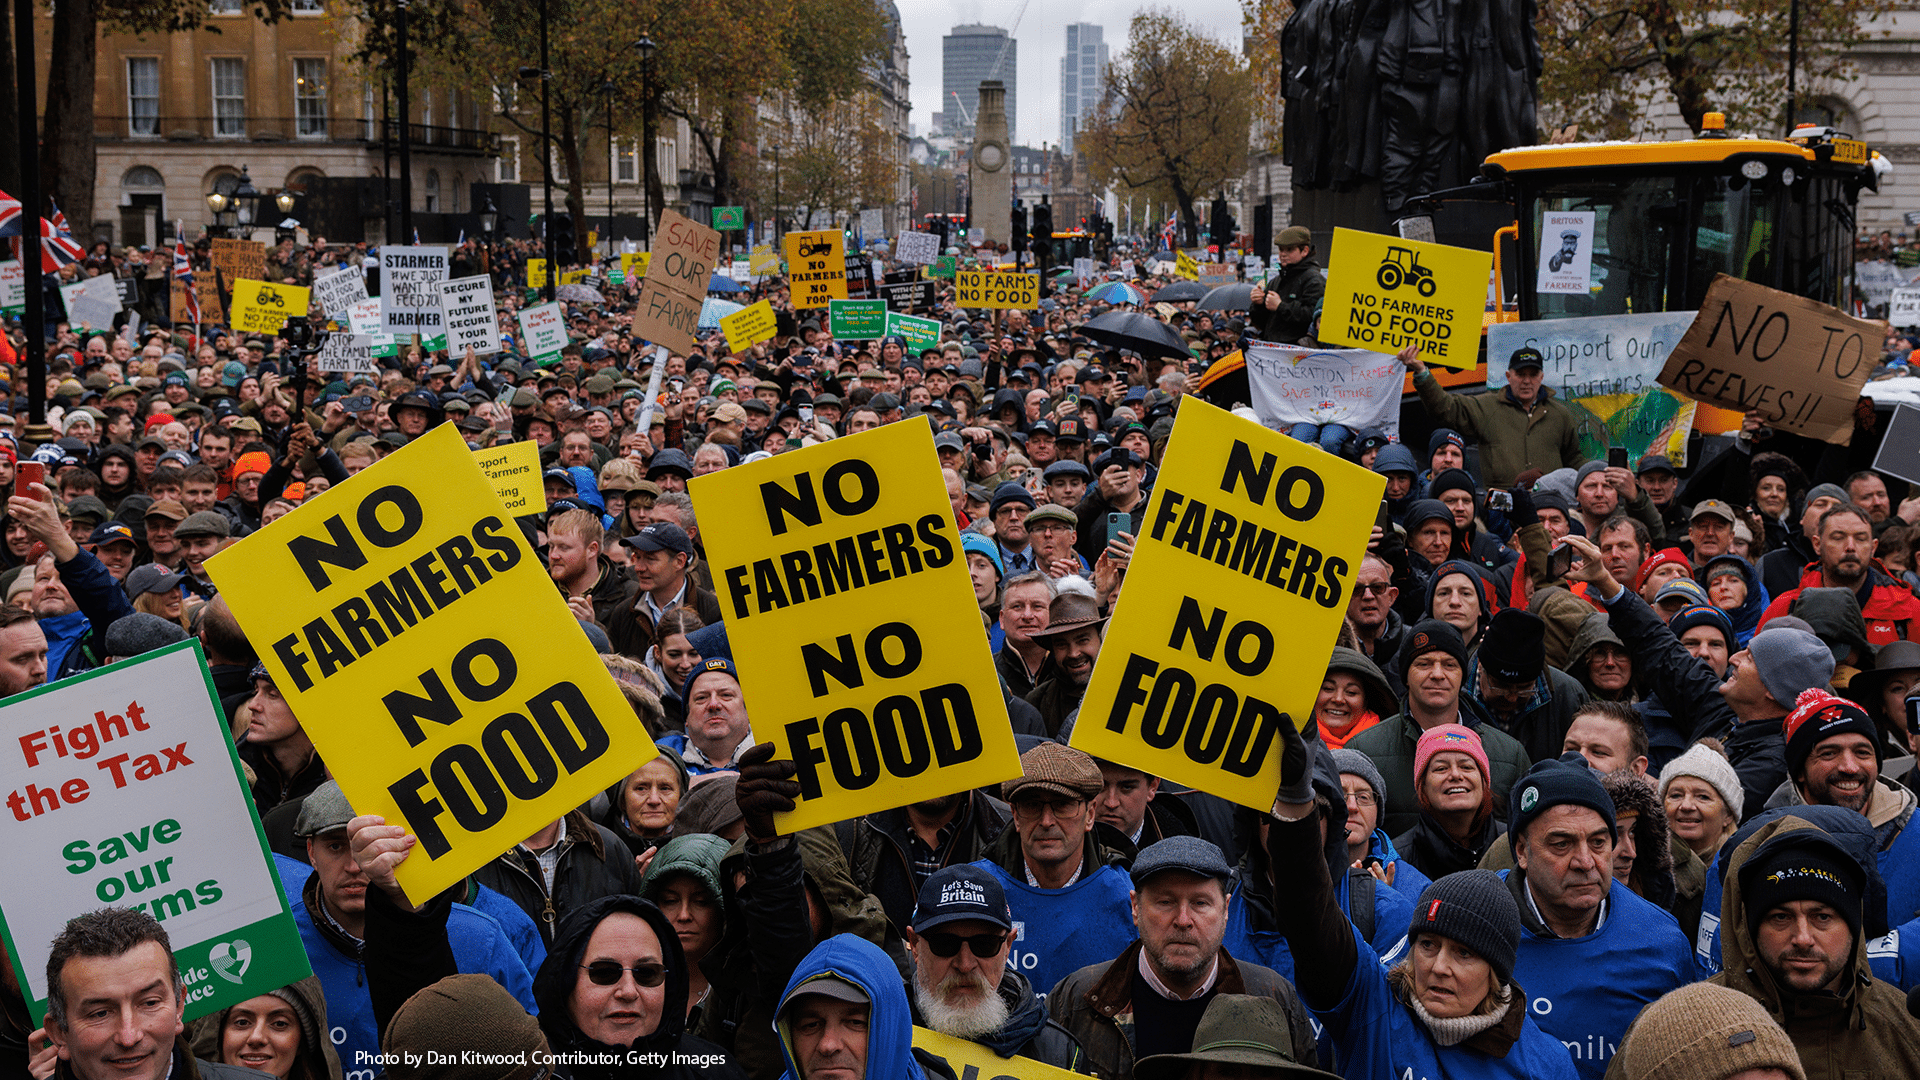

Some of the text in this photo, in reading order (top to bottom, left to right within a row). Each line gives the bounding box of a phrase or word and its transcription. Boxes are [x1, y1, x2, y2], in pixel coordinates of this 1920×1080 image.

[1551, 217, 1584, 225] BRITONS
[666, 222, 716, 262] SAVE
[385, 255, 444, 269] STARMER
[807, 261, 826, 270] NO
[391, 270, 444, 281] #WE JUST
[664, 253, 706, 288] OUR
[791, 271, 844, 283] FARMERS
[318, 268, 361, 292] NO FARMERS
[960, 274, 1036, 290] NO FARMS
[1545, 282, 1583, 290] FARMERS
[322, 282, 355, 304] NO FOOD
[392, 282, 422, 293] WANT
[443, 281, 487, 295] SECURE
[810, 284, 828, 294] NO
[325, 288, 366, 315] NO FUTURE
[396, 294, 425, 307] FEED
[458, 295, 474, 304] MY
[960, 289, 1031, 304] NO FOOD
[244, 306, 258, 314] NO
[357, 303, 379, 311] Fight
[448, 304, 489, 318] FUTURE
[646, 291, 699, 336] FARMS
[1353, 292, 1454, 322] NO FARMERS
[244, 313, 286, 326] NO FOO
[388, 312, 441, 326] HARMER
[530, 310, 550, 320] Fight
[243, 321, 257, 329] NO
[449, 315, 492, 330] SECURE
[527, 317, 557, 329] the Tax
[1349, 307, 1452, 340] NO FOOD
[458, 328, 488, 340] YOUR
[535, 329, 555, 338] Save
[1705, 300, 1864, 380] NO TO
[330, 334, 356, 348] STOP
[458, 340, 491, 352] FOOD.
[535, 339, 560, 350] Farms
[1347, 326, 1449, 357] NO FUTURE
[320, 347, 338, 358] THE
[341, 346, 373, 359] FAMILY
[1625, 337, 1664, 360] Our
[322, 359, 372, 371] FARM TAX
[1314, 385, 1330, 398] MY
[1333, 386, 1374, 399] FUTURE
[1561, 373, 1642, 402] Farmers
[1672, 359, 1823, 429] REEVES!!
[479, 455, 508, 469] pport
[485, 465, 530, 479] Farmers
[1219, 438, 1325, 522] NO
[505, 497, 526, 509] ood
[759, 458, 880, 536] NO
[287, 484, 424, 593] NO
[1150, 488, 1349, 609] FARMERS
[724, 513, 955, 620] FARMERS
[271, 515, 522, 693] FARMERS
[1167, 595, 1275, 677] NO
[800, 621, 923, 699] NO
[381, 637, 518, 748] NO
[1105, 652, 1281, 778] FOOD
[18, 700, 150, 768] Fight
[784, 682, 984, 802] FOOD
[386, 680, 611, 862] FOOD
[6, 741, 195, 822] the Tax
[61, 818, 182, 875] Save
[96, 857, 174, 903] our
[942, 879, 984, 893] Let's Save
[940, 890, 986, 903] Britain
